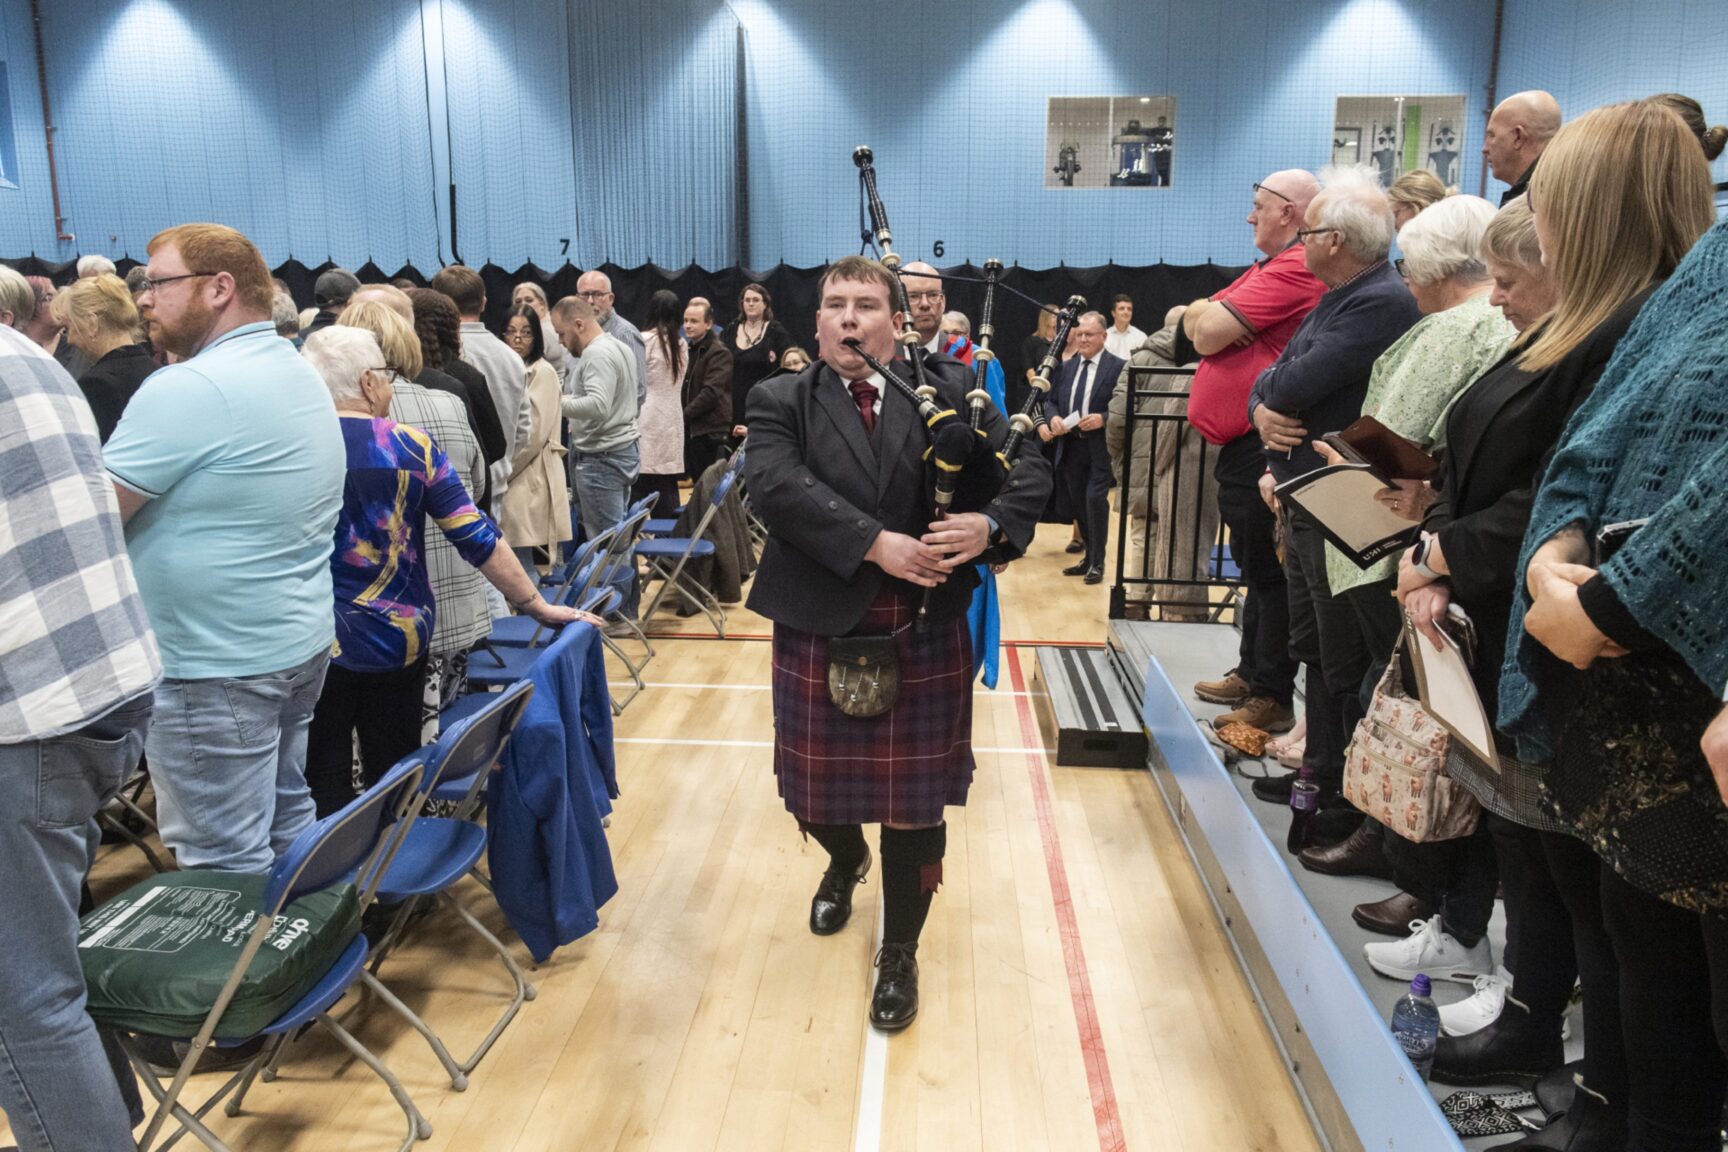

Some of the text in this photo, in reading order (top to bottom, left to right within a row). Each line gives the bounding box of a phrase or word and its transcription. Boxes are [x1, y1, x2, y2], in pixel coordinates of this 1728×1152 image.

[560, 239, 570, 255] 7
[933, 240, 944, 258] 6
[272, 918, 309, 950] drive
